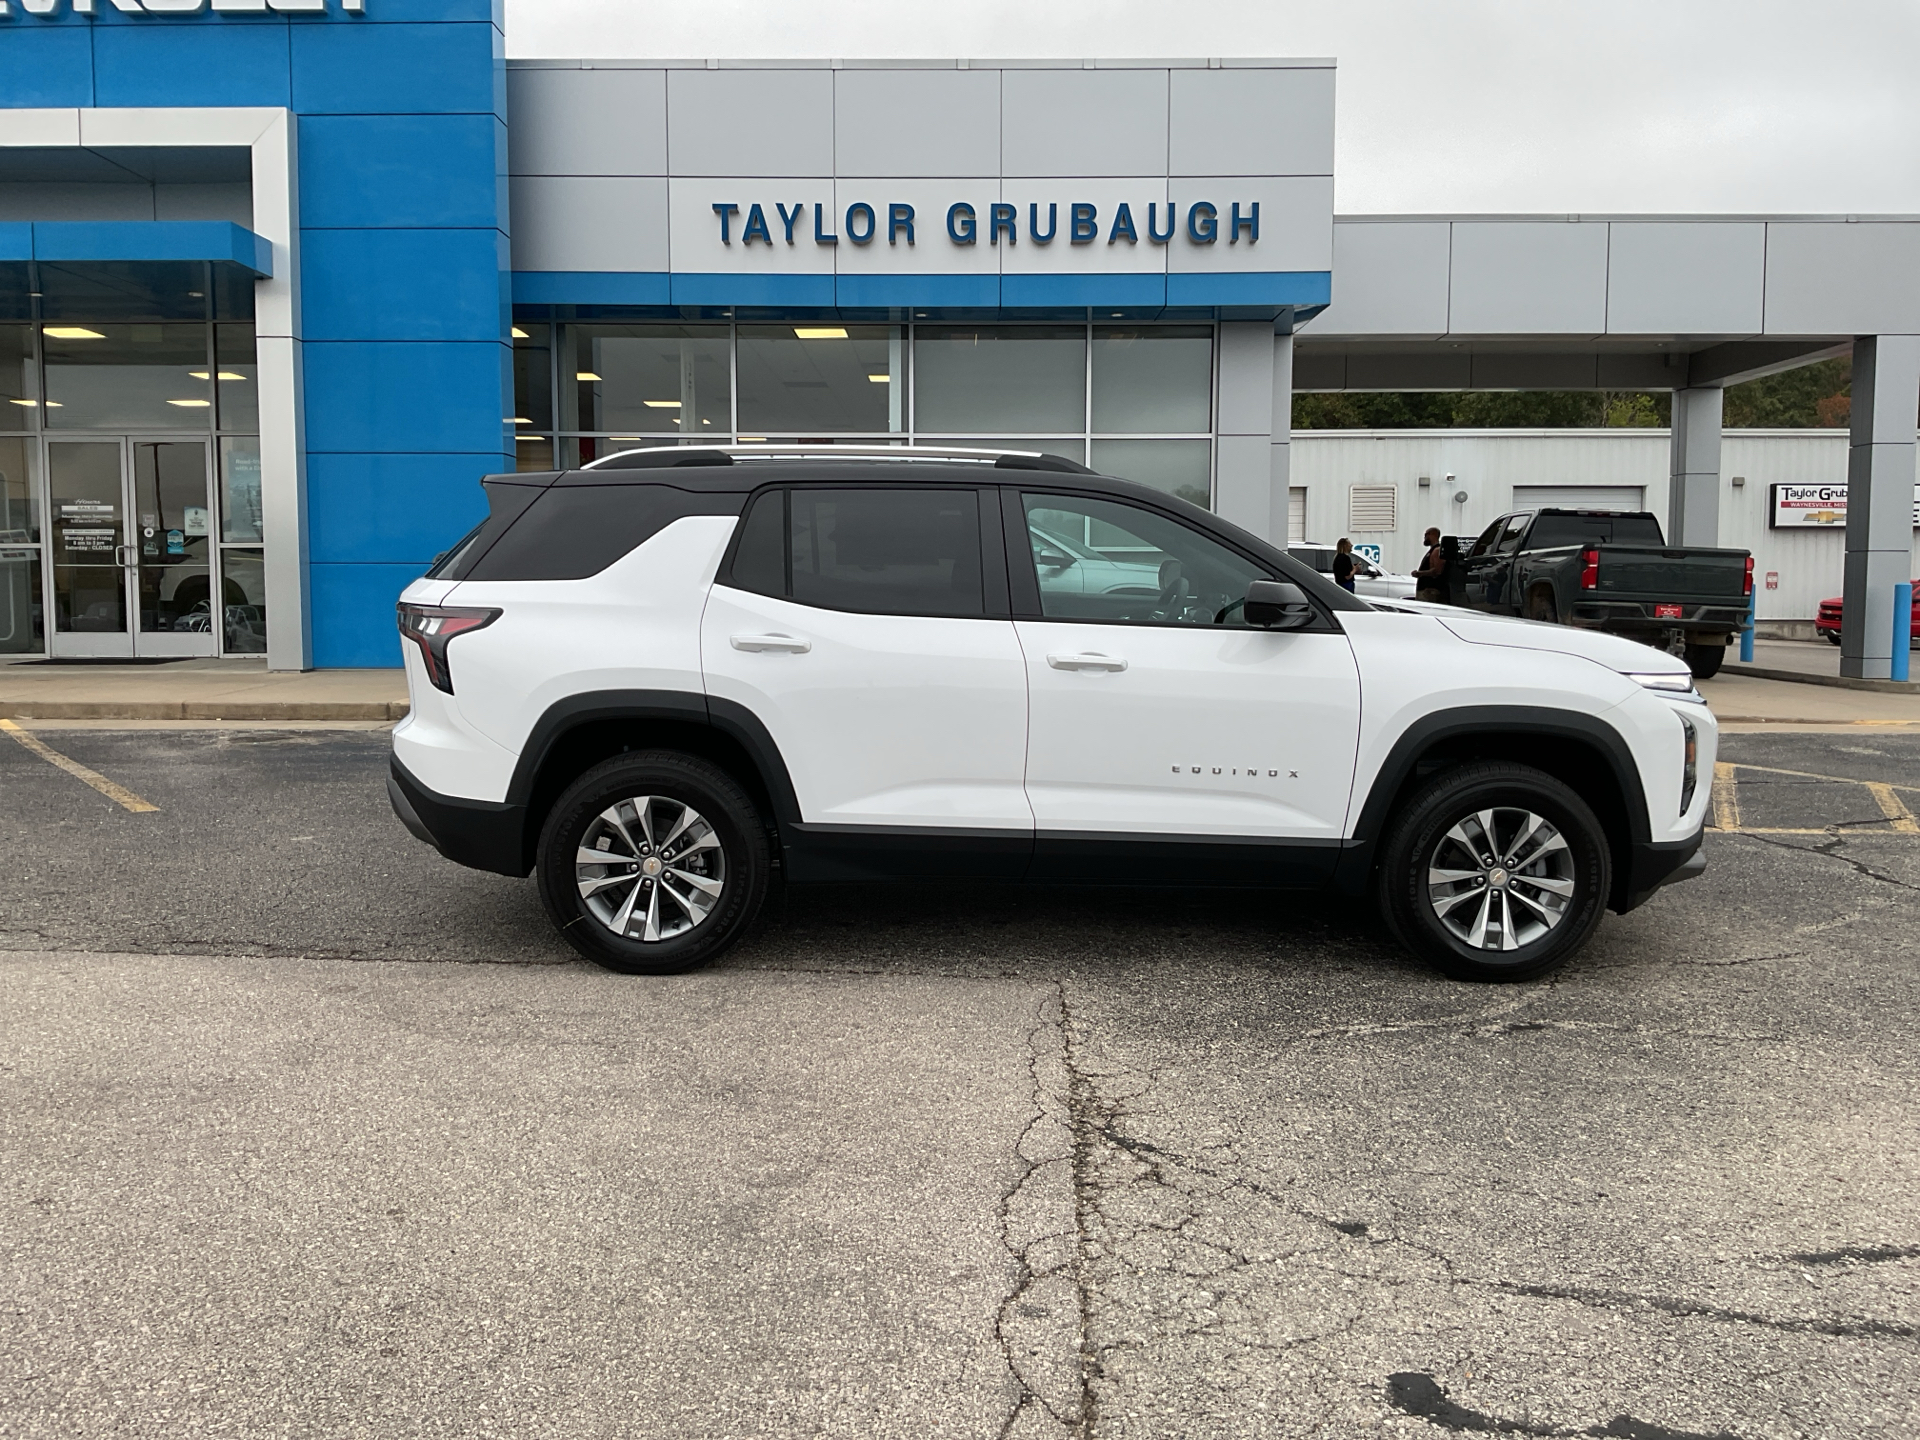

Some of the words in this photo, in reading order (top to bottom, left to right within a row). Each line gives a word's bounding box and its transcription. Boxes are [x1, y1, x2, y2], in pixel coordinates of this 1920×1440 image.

[712, 202, 915, 246] TAYLOR
[946, 201, 1260, 246] GRUBAUGH
[1781, 487, 1817, 500] Taylor
[1818, 487, 1848, 501] Grub
[1171, 765, 1299, 778] EQUINOX
